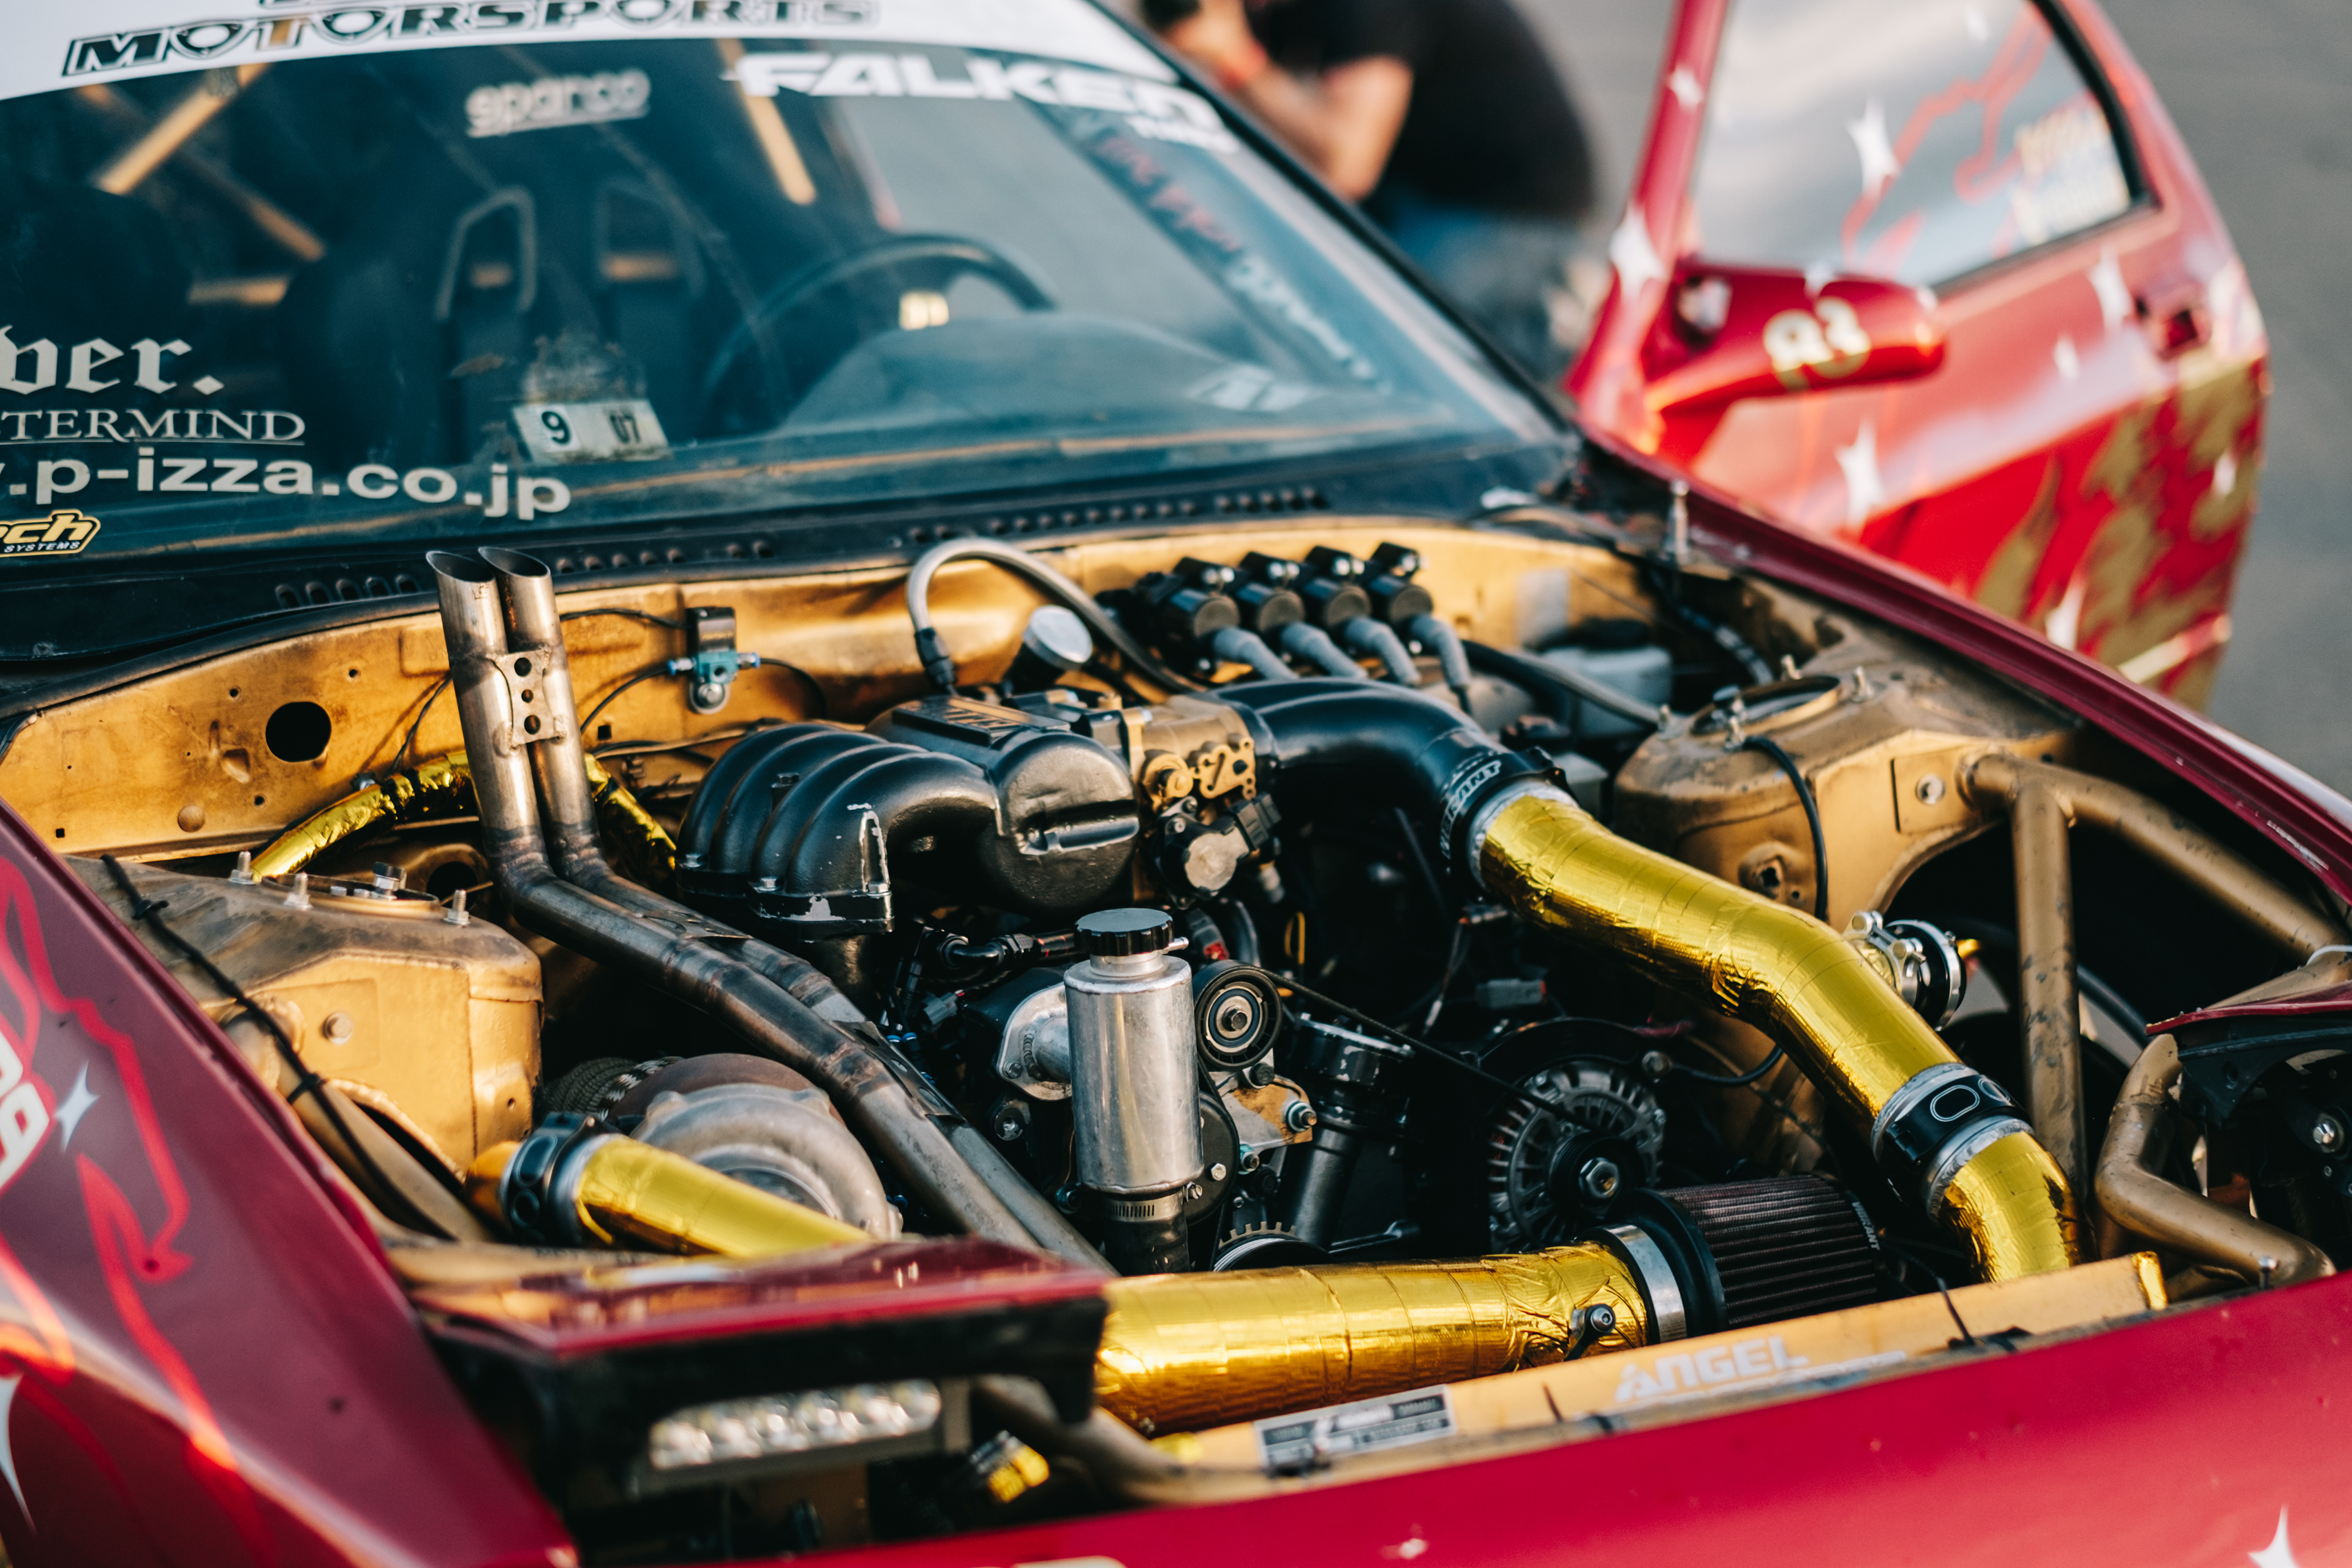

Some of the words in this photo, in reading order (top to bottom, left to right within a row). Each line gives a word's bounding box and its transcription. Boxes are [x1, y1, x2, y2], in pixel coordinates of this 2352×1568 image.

[62, 0, 881, 76] MOTORSPORTS
[464, 69, 650, 137] sparco
[1, 409, 306, 443] TERMIND
[541, 411, 570, 444] 9
[0, 447, 571, 520] .p-izza.co.jp
[0, 514, 93, 544] ch
[4, 541, 80, 552] SYSTEMS
